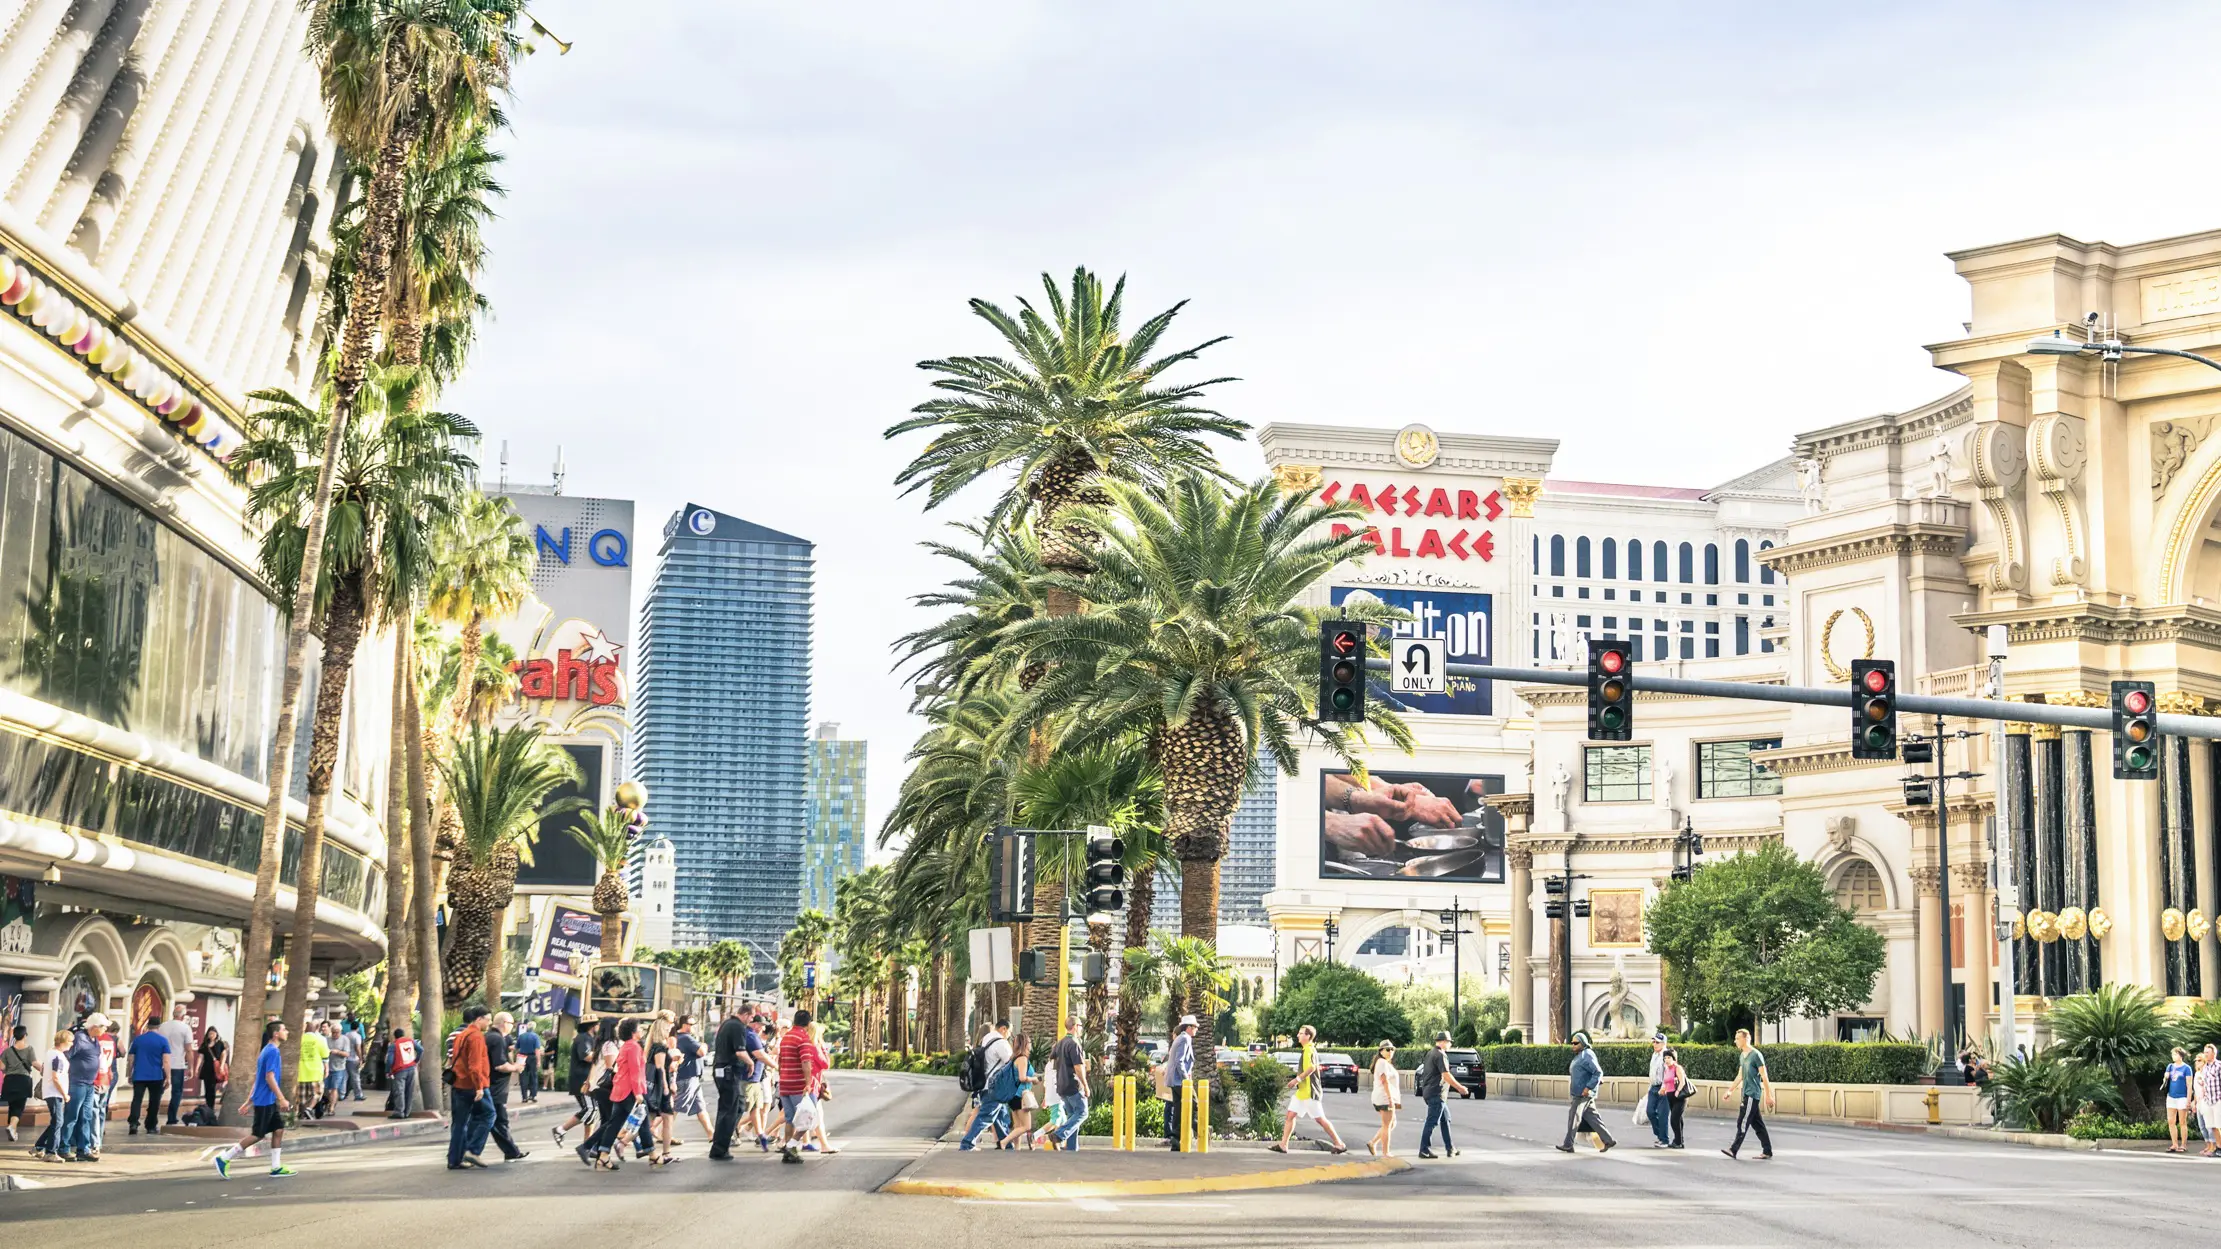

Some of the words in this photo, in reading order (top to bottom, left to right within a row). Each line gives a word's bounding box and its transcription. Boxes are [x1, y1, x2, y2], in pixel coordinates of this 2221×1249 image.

[1319, 480, 1504, 522] CAESARS
[1402, 676, 1434, 690] ONLY
[1451, 680, 1477, 692] PIANO
[551, 936, 566, 949] REAL
[550, 947, 569, 961] NIGHT
